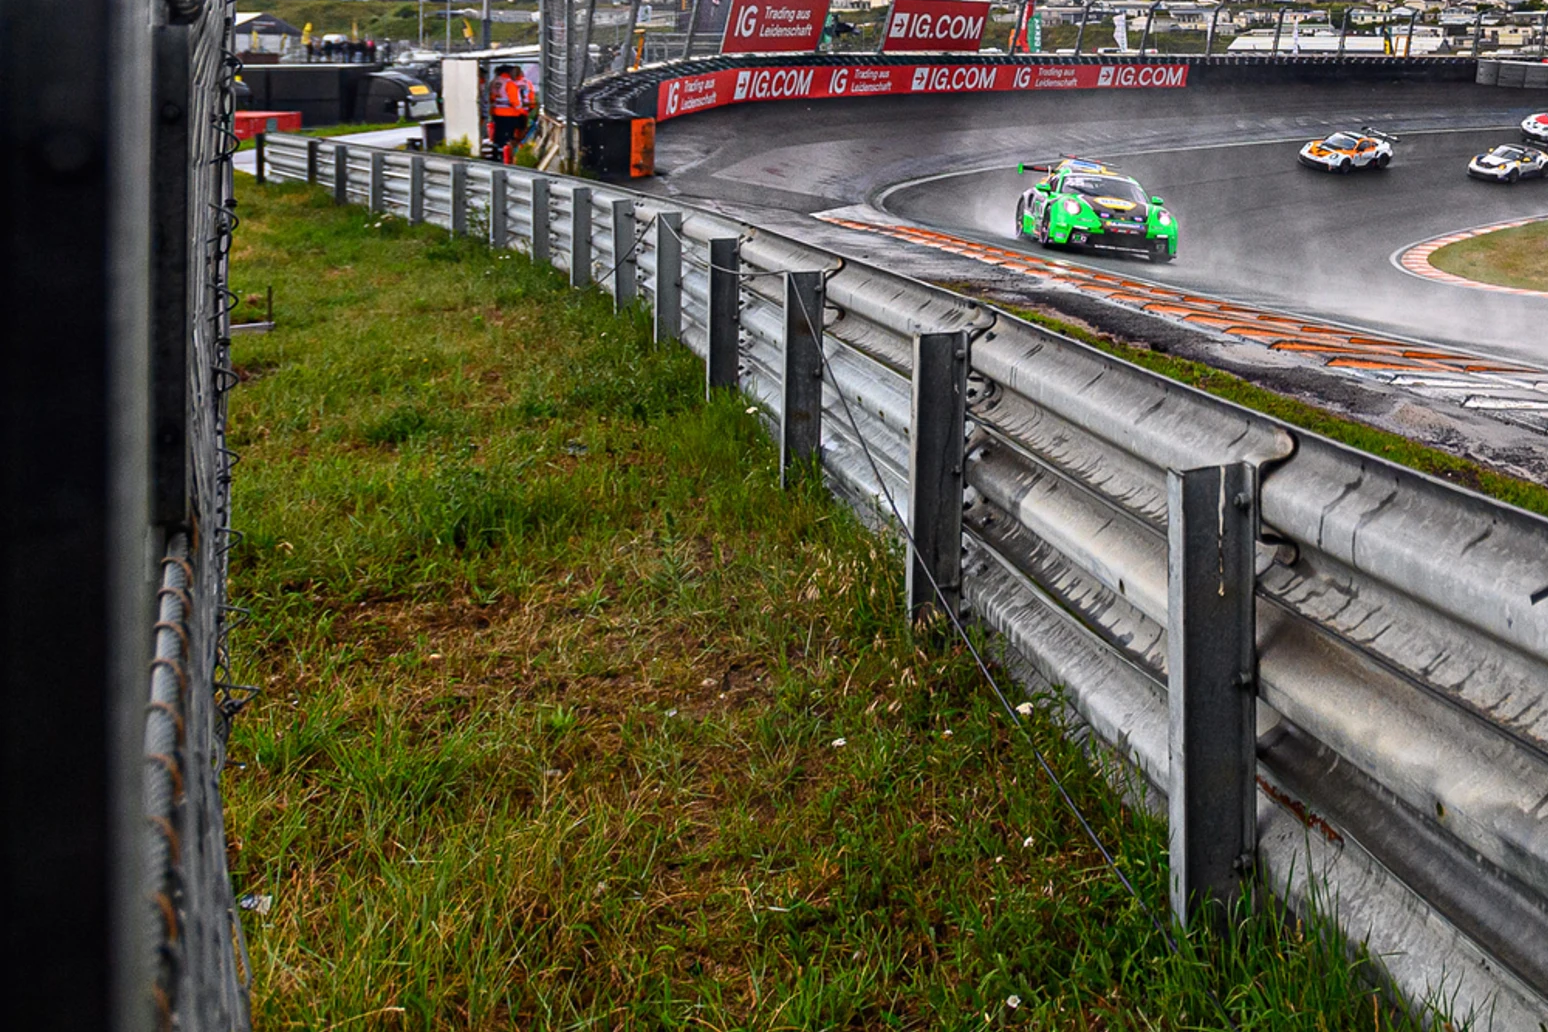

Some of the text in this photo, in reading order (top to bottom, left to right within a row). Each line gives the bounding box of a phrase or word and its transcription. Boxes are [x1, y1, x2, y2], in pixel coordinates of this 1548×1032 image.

[734, 5, 759, 38] IG
[764, 6, 811, 22] Trading aus
[759, 23, 813, 38] Leidenschaft
[908, 13, 984, 40] IG.COM
[828, 68, 848, 94] IG
[854, 69, 890, 80] Trading aus
[928, 67, 997, 90] IG.COM
[1013, 67, 1031, 88] IG
[1034, 78, 1077, 88] Leidenschaft
[1038, 68, 1063, 78] Trading
[1115, 66, 1184, 86] IG.COM
[749, 69, 814, 98] IG.COM
[851, 82, 892, 93] Leidenschaft
[666, 81, 680, 116] IG
